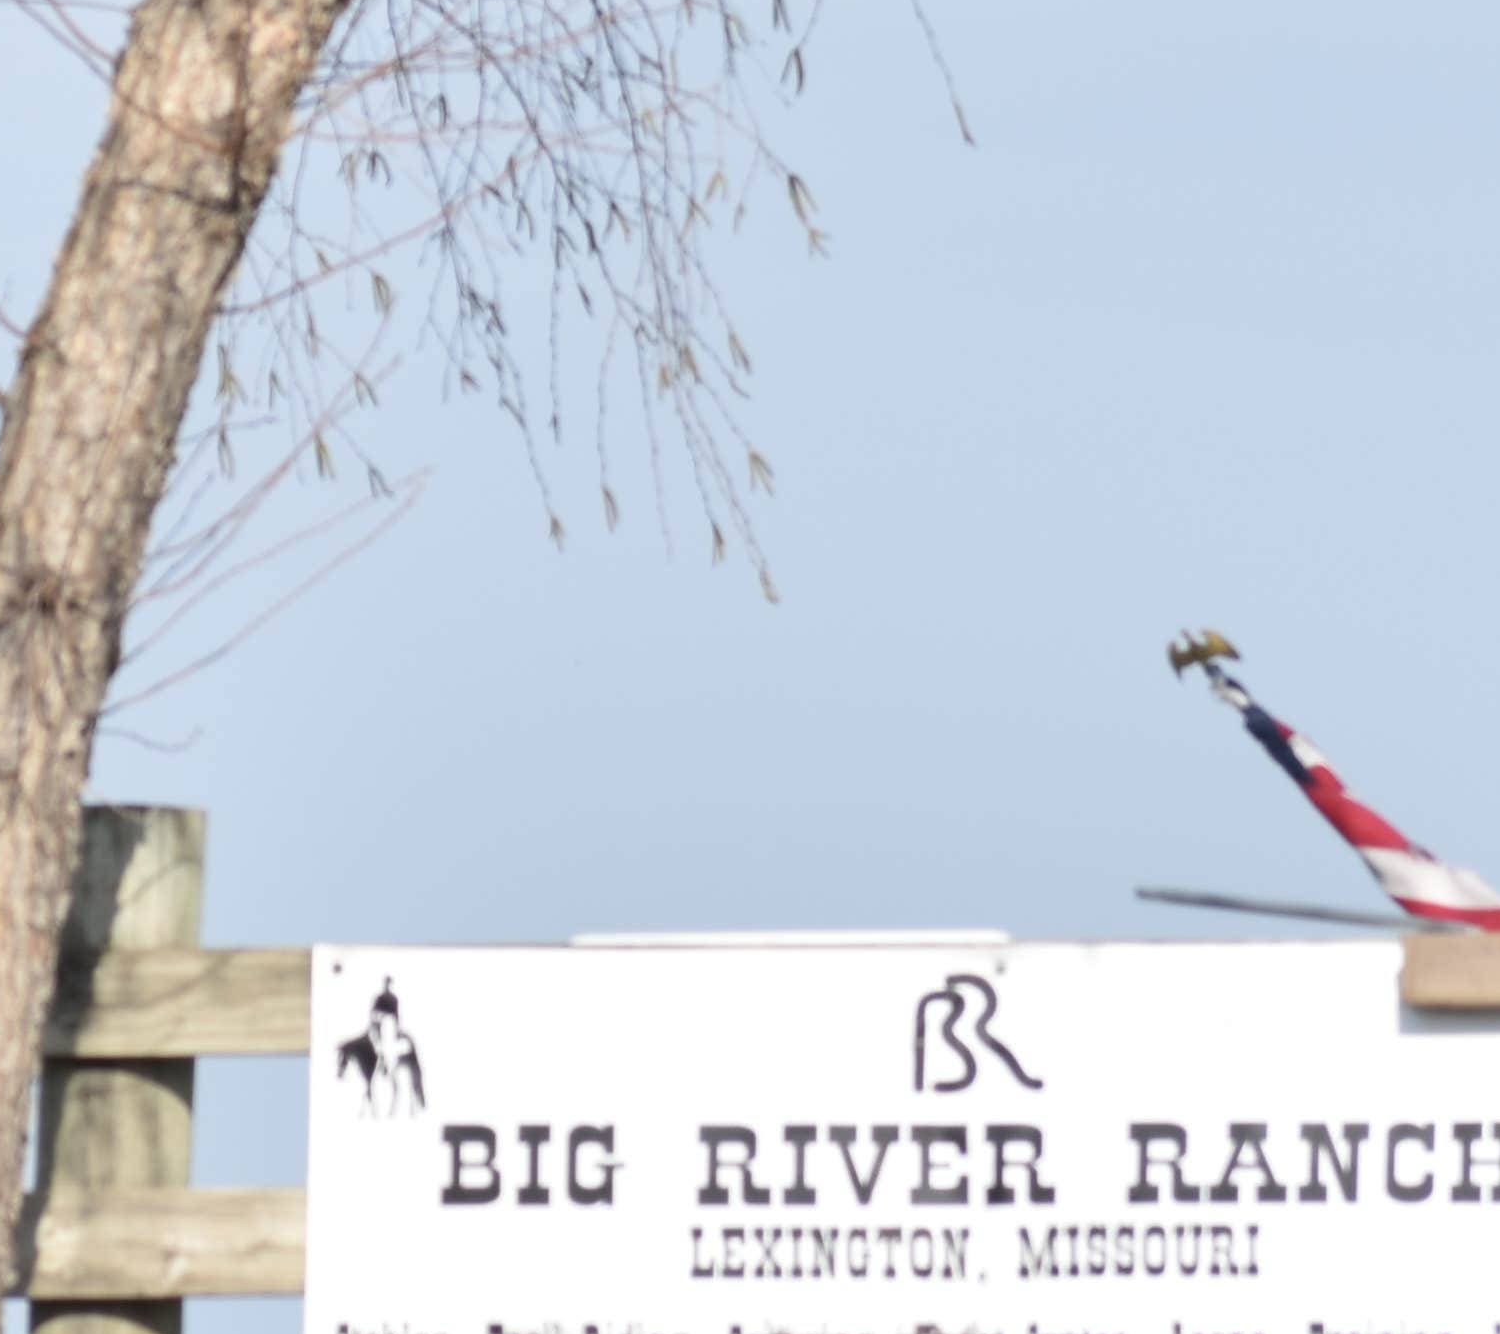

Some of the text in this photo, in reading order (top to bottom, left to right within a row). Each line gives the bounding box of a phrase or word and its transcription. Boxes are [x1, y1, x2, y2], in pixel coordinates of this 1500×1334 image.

[440, 1124, 624, 1206] BIG
[697, 1123, 1056, 1206] RIVER
[690, 1224, 1262, 1283] LEXINGTON, MISSOURI
